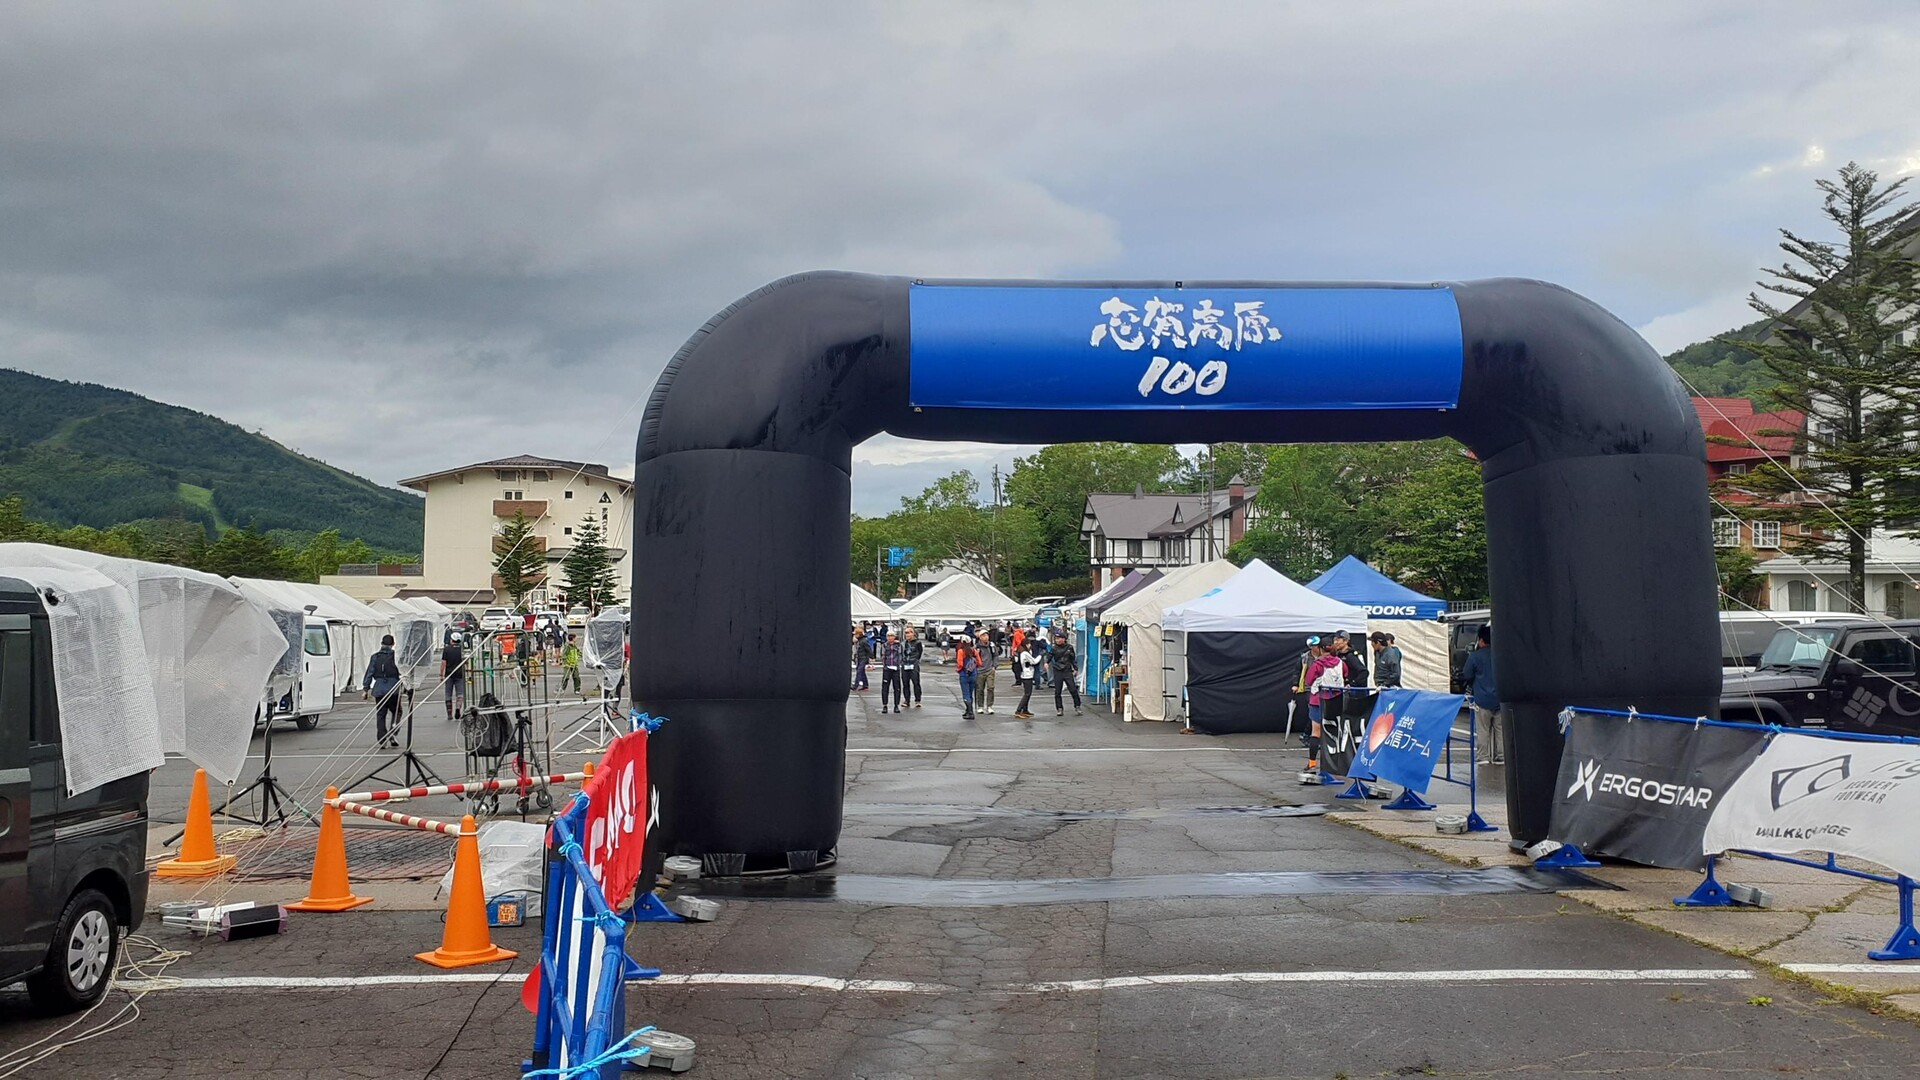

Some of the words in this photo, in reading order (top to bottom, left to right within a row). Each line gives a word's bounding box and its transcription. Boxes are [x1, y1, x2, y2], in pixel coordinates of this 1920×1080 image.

[1089, 296, 1283, 352] 志賀高原
[1138, 356, 1228, 397] 100
[1598, 772, 1713, 810] ERGOSTAR
[1833, 790, 1888, 805] FOOTWEAR
